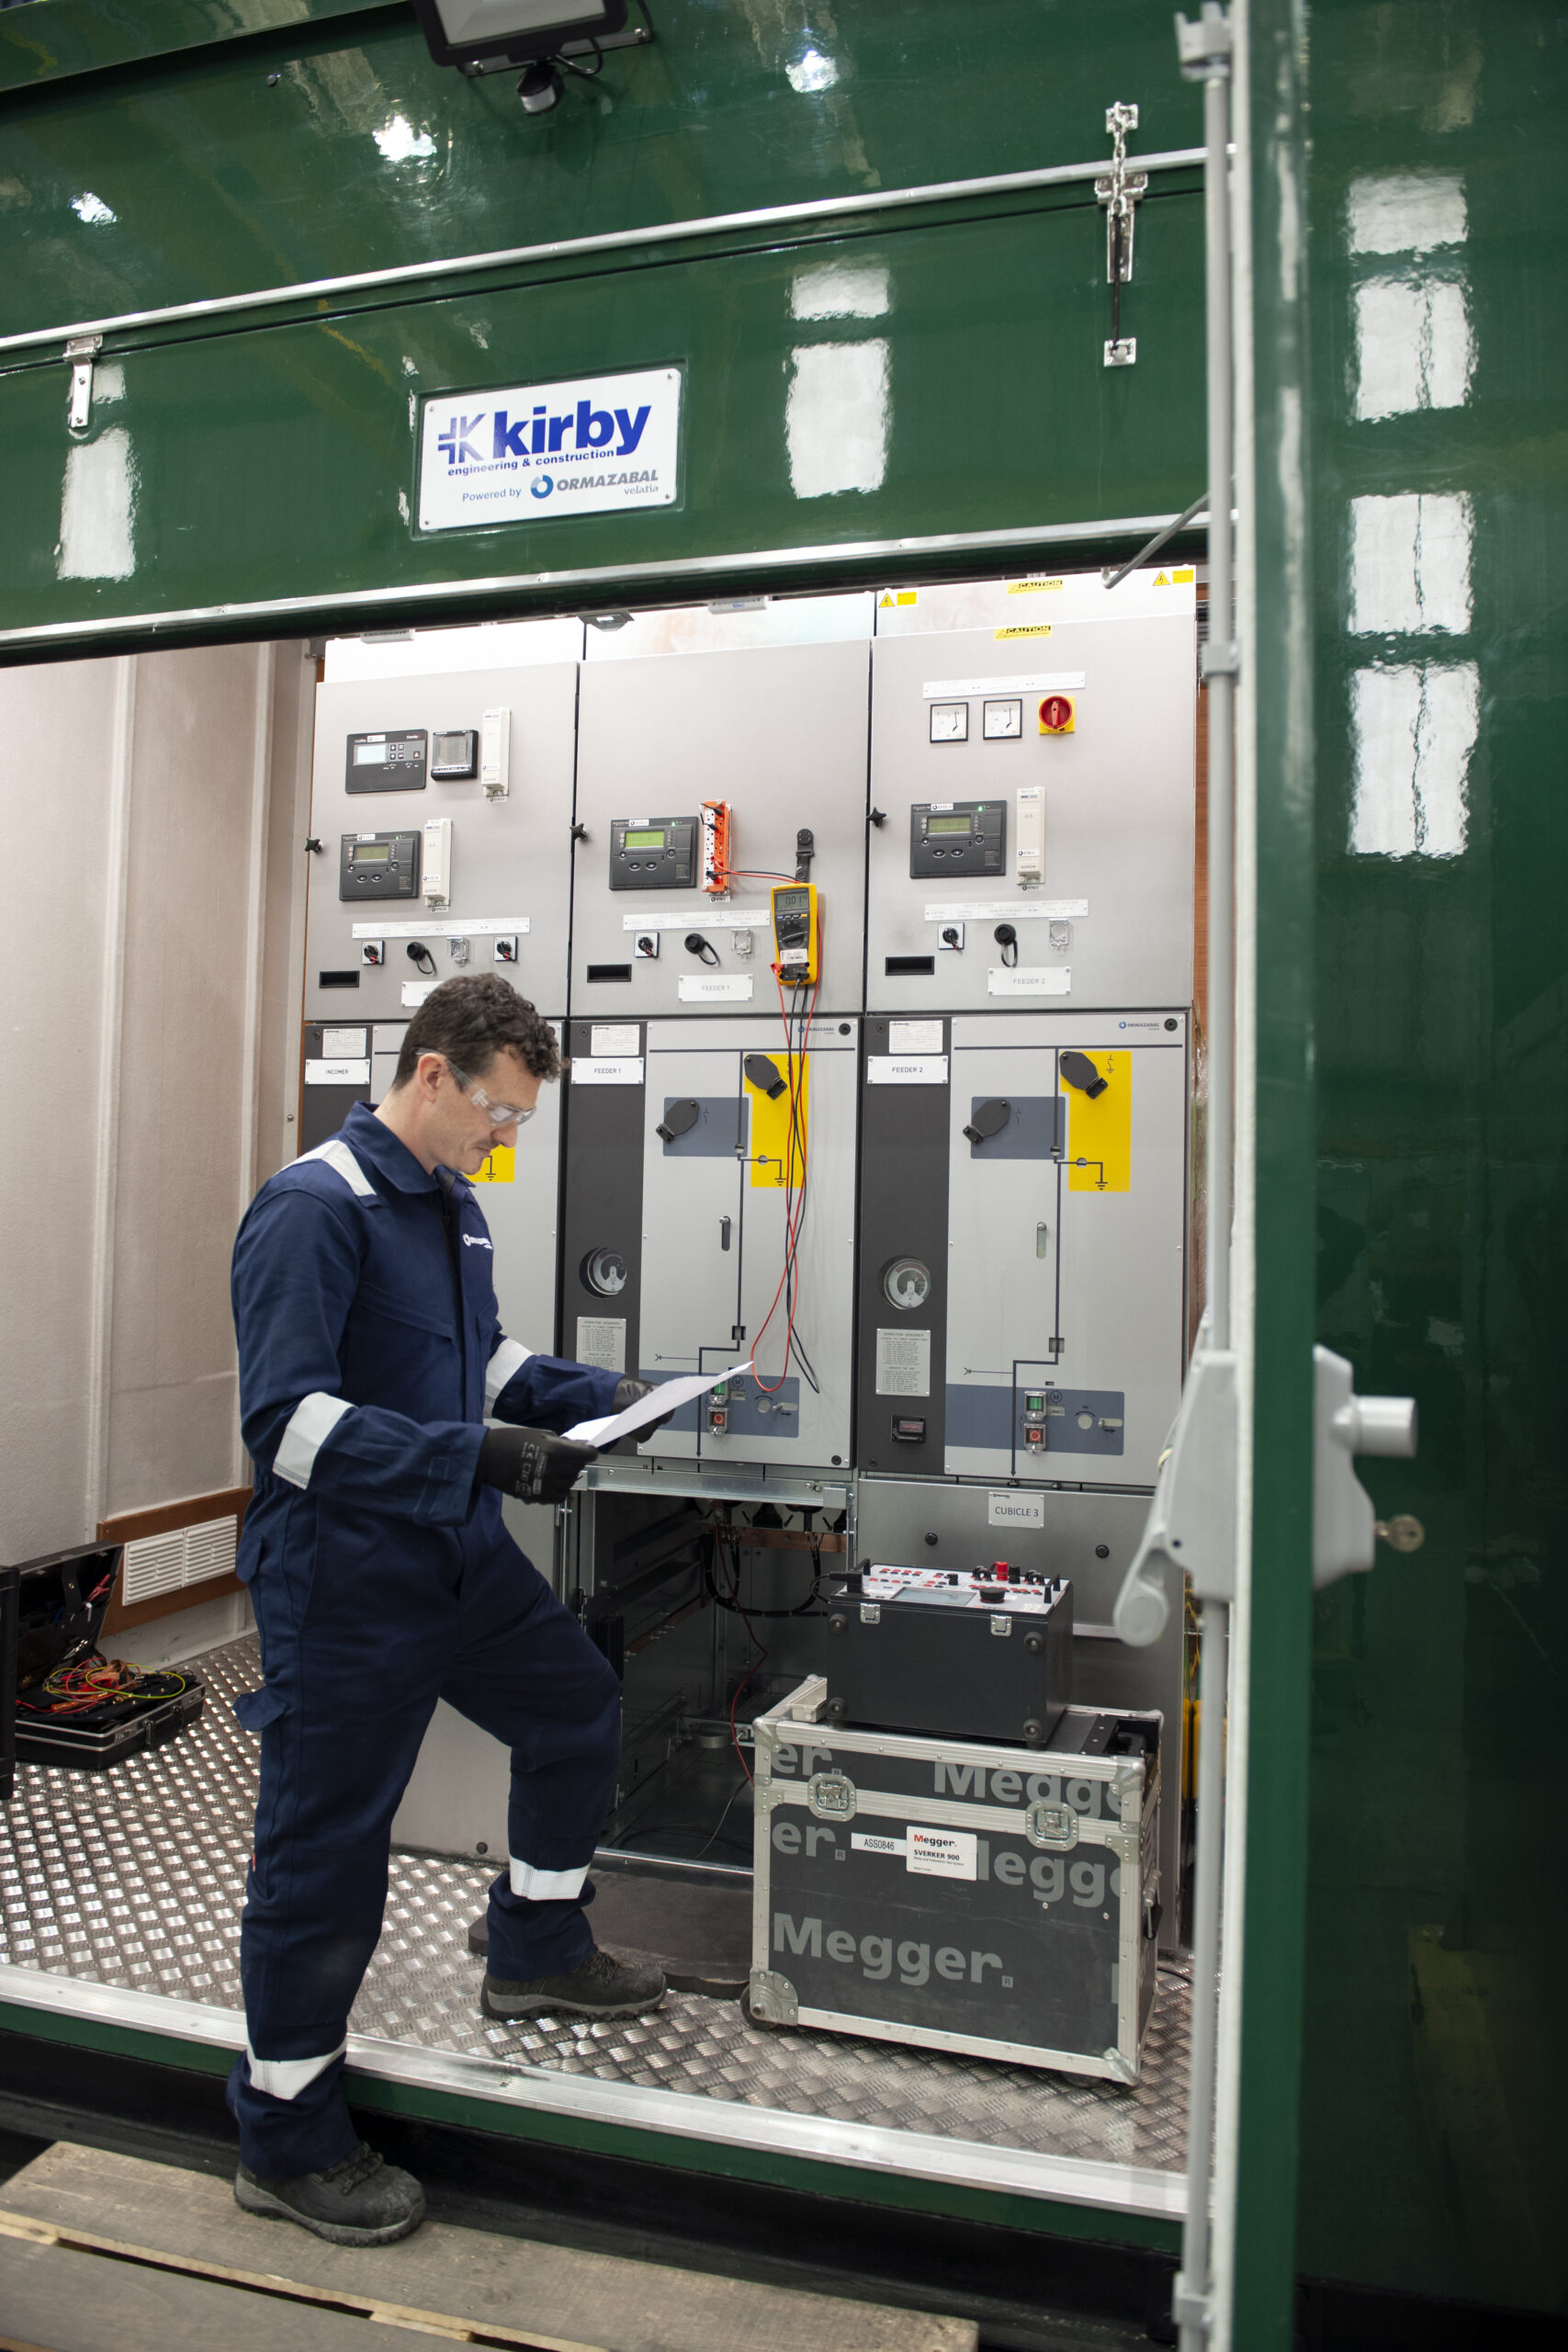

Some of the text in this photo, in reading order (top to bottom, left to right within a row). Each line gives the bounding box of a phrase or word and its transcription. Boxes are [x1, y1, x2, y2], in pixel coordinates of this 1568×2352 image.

[492, 400, 652, 459] kirby
[447, 449, 615, 476] engineering & construction
[557, 469, 659, 492] ORMAZABAL
[462, 488, 522, 503] Powered by
[624, 484, 659, 495] velatia
[1019, 580, 1062, 589] CAUTION
[1007, 626, 1051, 634] CAUTION
[995, 1506, 1039, 1517] CUBICLE 3
[914, 1849, 960, 1861] SVERKER 900
